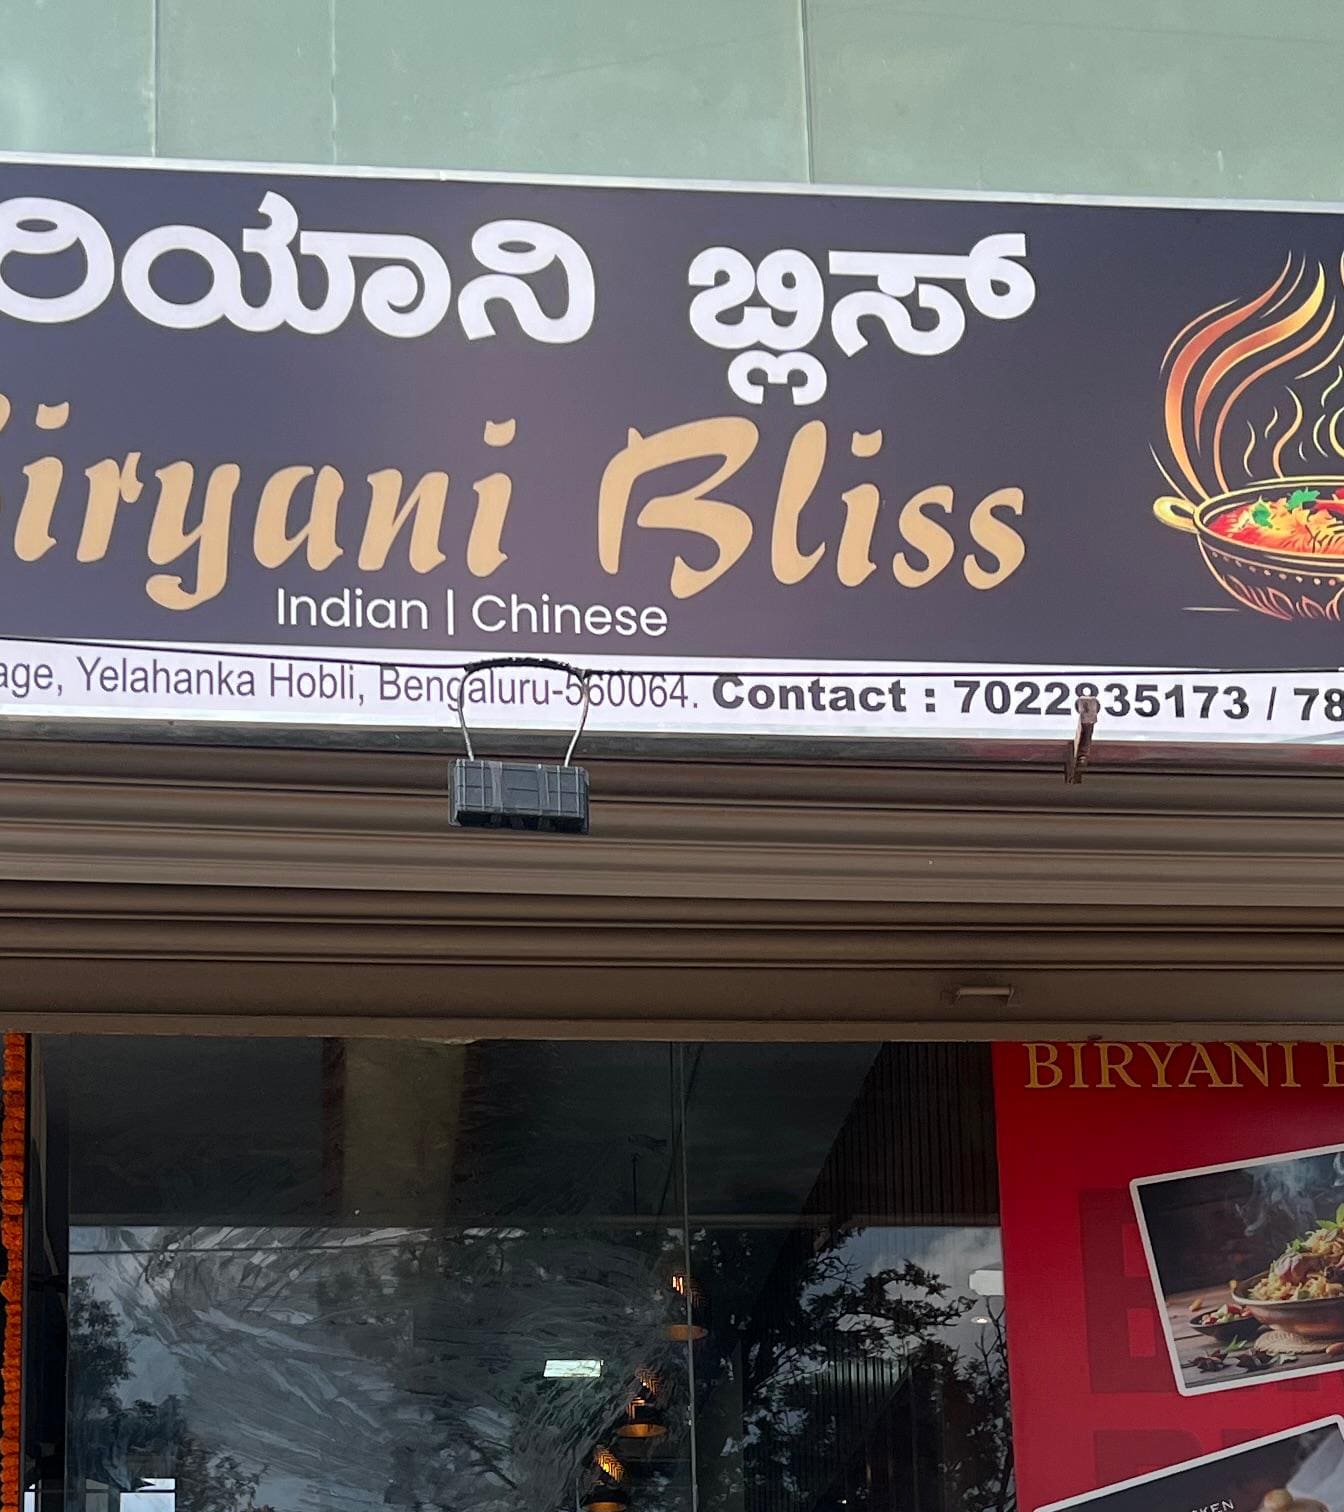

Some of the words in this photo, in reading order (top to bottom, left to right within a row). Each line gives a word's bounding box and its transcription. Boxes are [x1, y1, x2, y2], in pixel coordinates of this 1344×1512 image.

[688, 233, 1036, 405] ಬ್ಲಿಸ್
[598, 416, 1025, 599] Bliss
[276, 588, 428, 630] Indian
[471, 594, 668, 636] Chinese
[75, 656, 257, 699] Yelahanka
[269, 664, 365, 706] Hobli,
[712, 676, 907, 713] Contact
[953, 680, 1251, 721] 7022835173
[1022, 1042, 1302, 1089] BIRYANI
